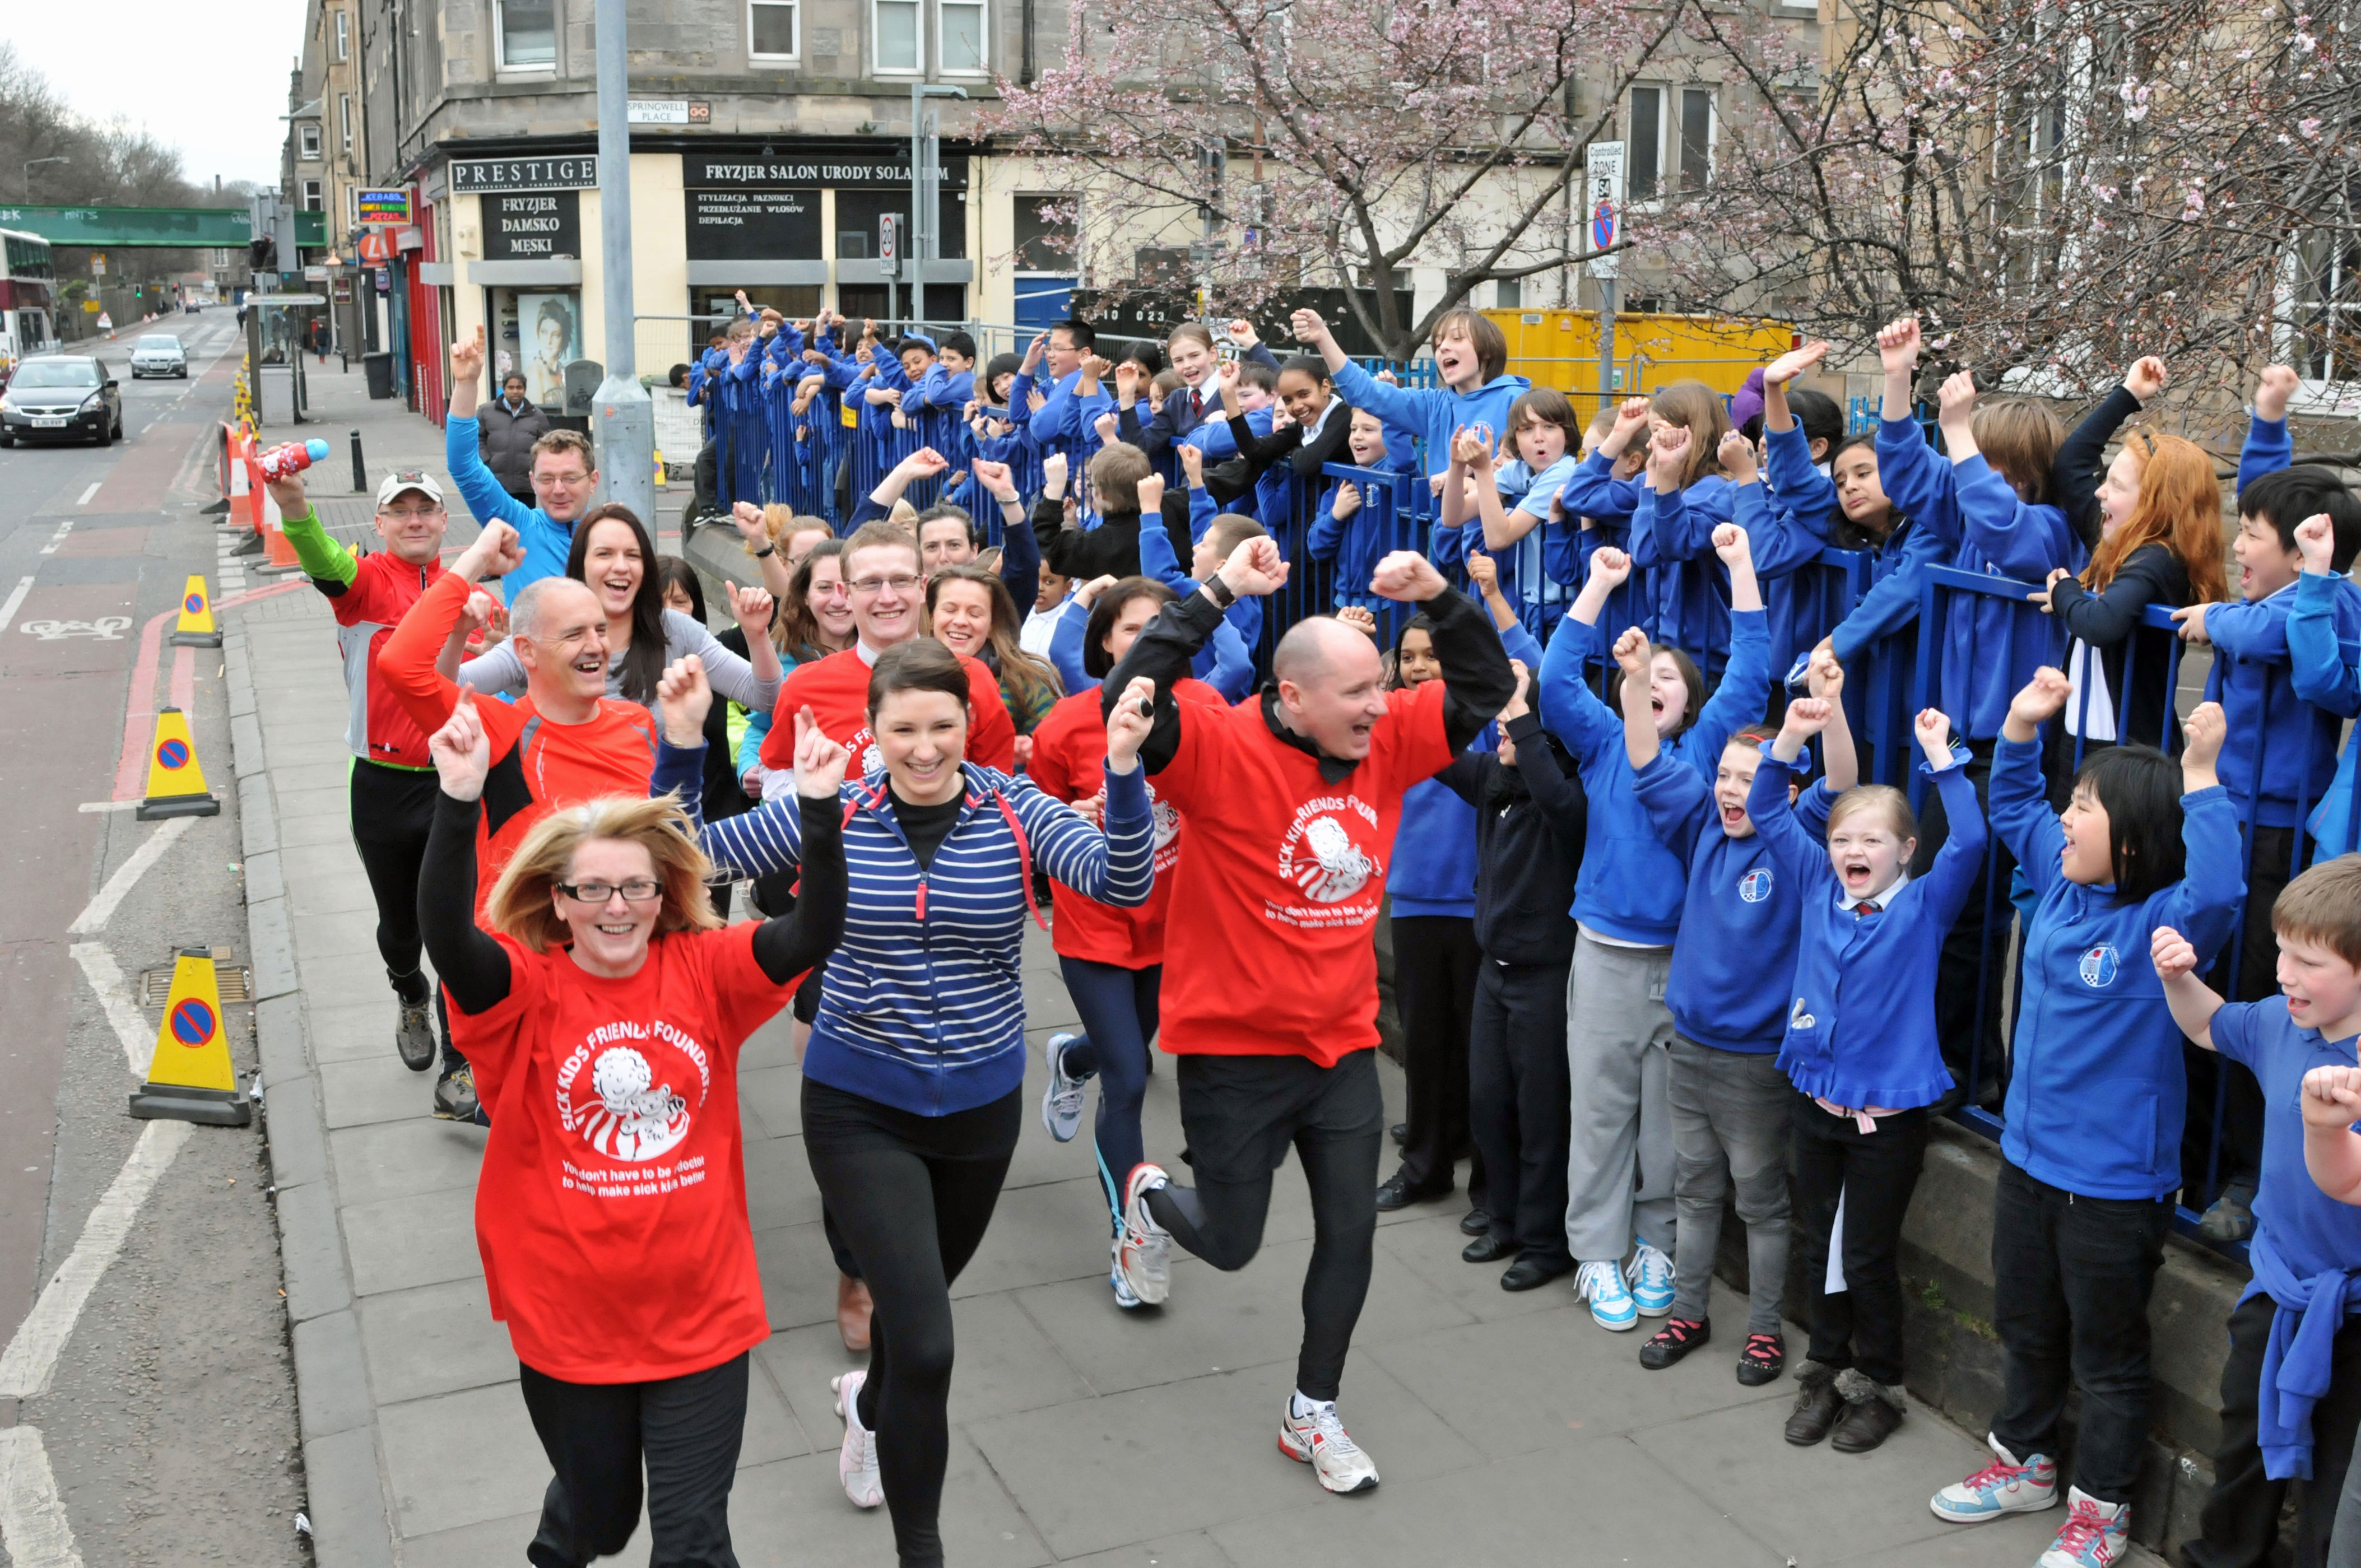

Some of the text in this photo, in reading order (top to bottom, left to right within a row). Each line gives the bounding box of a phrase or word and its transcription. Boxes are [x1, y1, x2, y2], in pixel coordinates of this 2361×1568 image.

[628, 103, 685, 111] SPRINGWELL
[1591, 146, 1621, 156] Controlled
[456, 161, 594, 183] PRESTIGE
[706, 165, 766, 182] FRYZJER
[770, 165, 817, 179] SALON
[822, 166, 872, 179] URODY
[1594, 160, 1616, 173] ZONE
[1598, 180, 1610, 196] S4
[502, 197, 557, 215] FRYZJER
[698, 194, 747, 203] STYLIZACJA
[501, 218, 560, 232] DAMSKO
[698, 217, 743, 226] DEPILACJA
[882, 229, 891, 245] 20
[510, 239, 552, 255] MĘSKI
[881, 260, 894, 269] ZONE
[1278, 842, 1295, 878] SICK
[1331, 906, 1343, 916] to
[1342, 905, 1356, 915] be
[557, 1044, 590, 1090] KIDS
[556, 1088, 577, 1131] SICK
[563, 1159, 579, 1177] You
[579, 1169, 608, 1183] don't
[610, 1169, 640, 1181] have
[642, 1167, 655, 1180] to
[657, 1165, 671, 1179] be
[677, 1155, 705, 1172] doctor
[563, 1175, 574, 1189] to
[576, 1179, 596, 1197] help
[598, 1184, 630, 1197] make
[633, 1181, 658, 1195] sick
[680, 1170, 705, 1187] better
